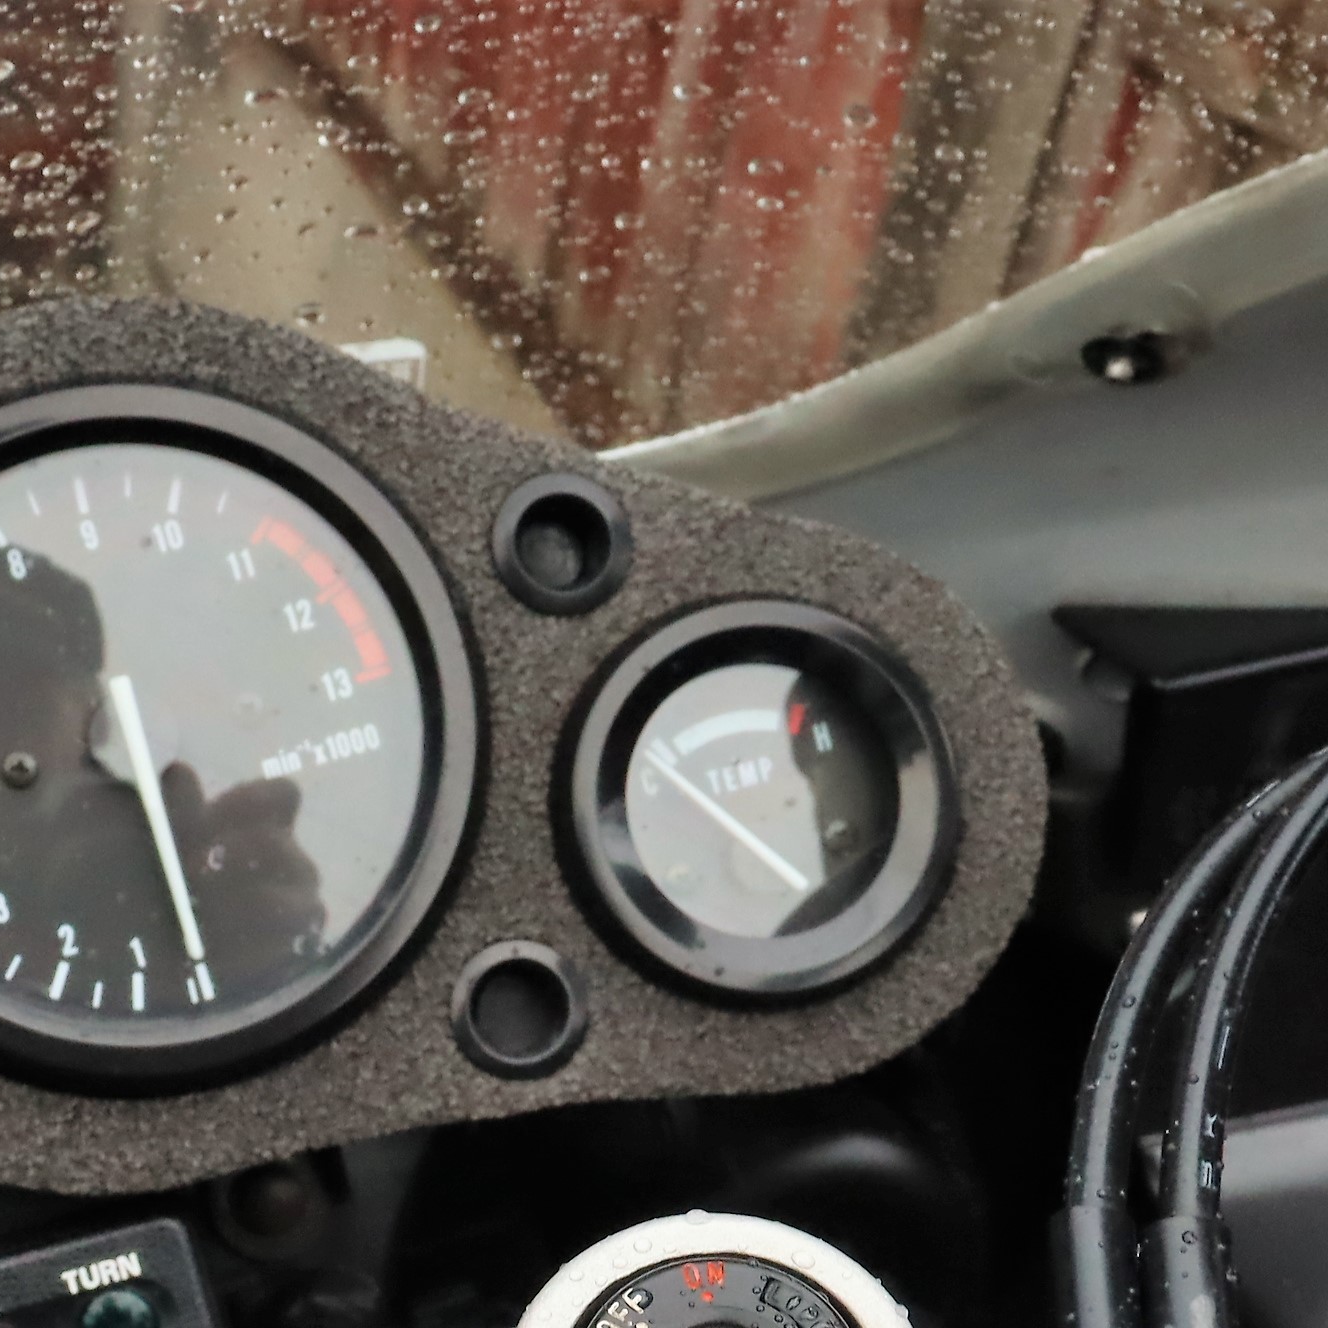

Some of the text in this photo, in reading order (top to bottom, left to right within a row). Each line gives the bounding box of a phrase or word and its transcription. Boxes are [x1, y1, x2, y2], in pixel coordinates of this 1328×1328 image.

[79, 518, 99, 551] 9
[152, 518, 184, 553] 10
[6, 547, 28, 581] 8
[226, 548, 256, 582] 11
[283, 598, 316, 633] 12
[322, 667, 354, 702] 13
[704, 755, 773, 797] TEMP
[56, 922, 80, 957] 2
[128, 935, 147, 969] 1
[59, 1250, 144, 1296] TURN
[681, 1261, 725, 1290] ON
